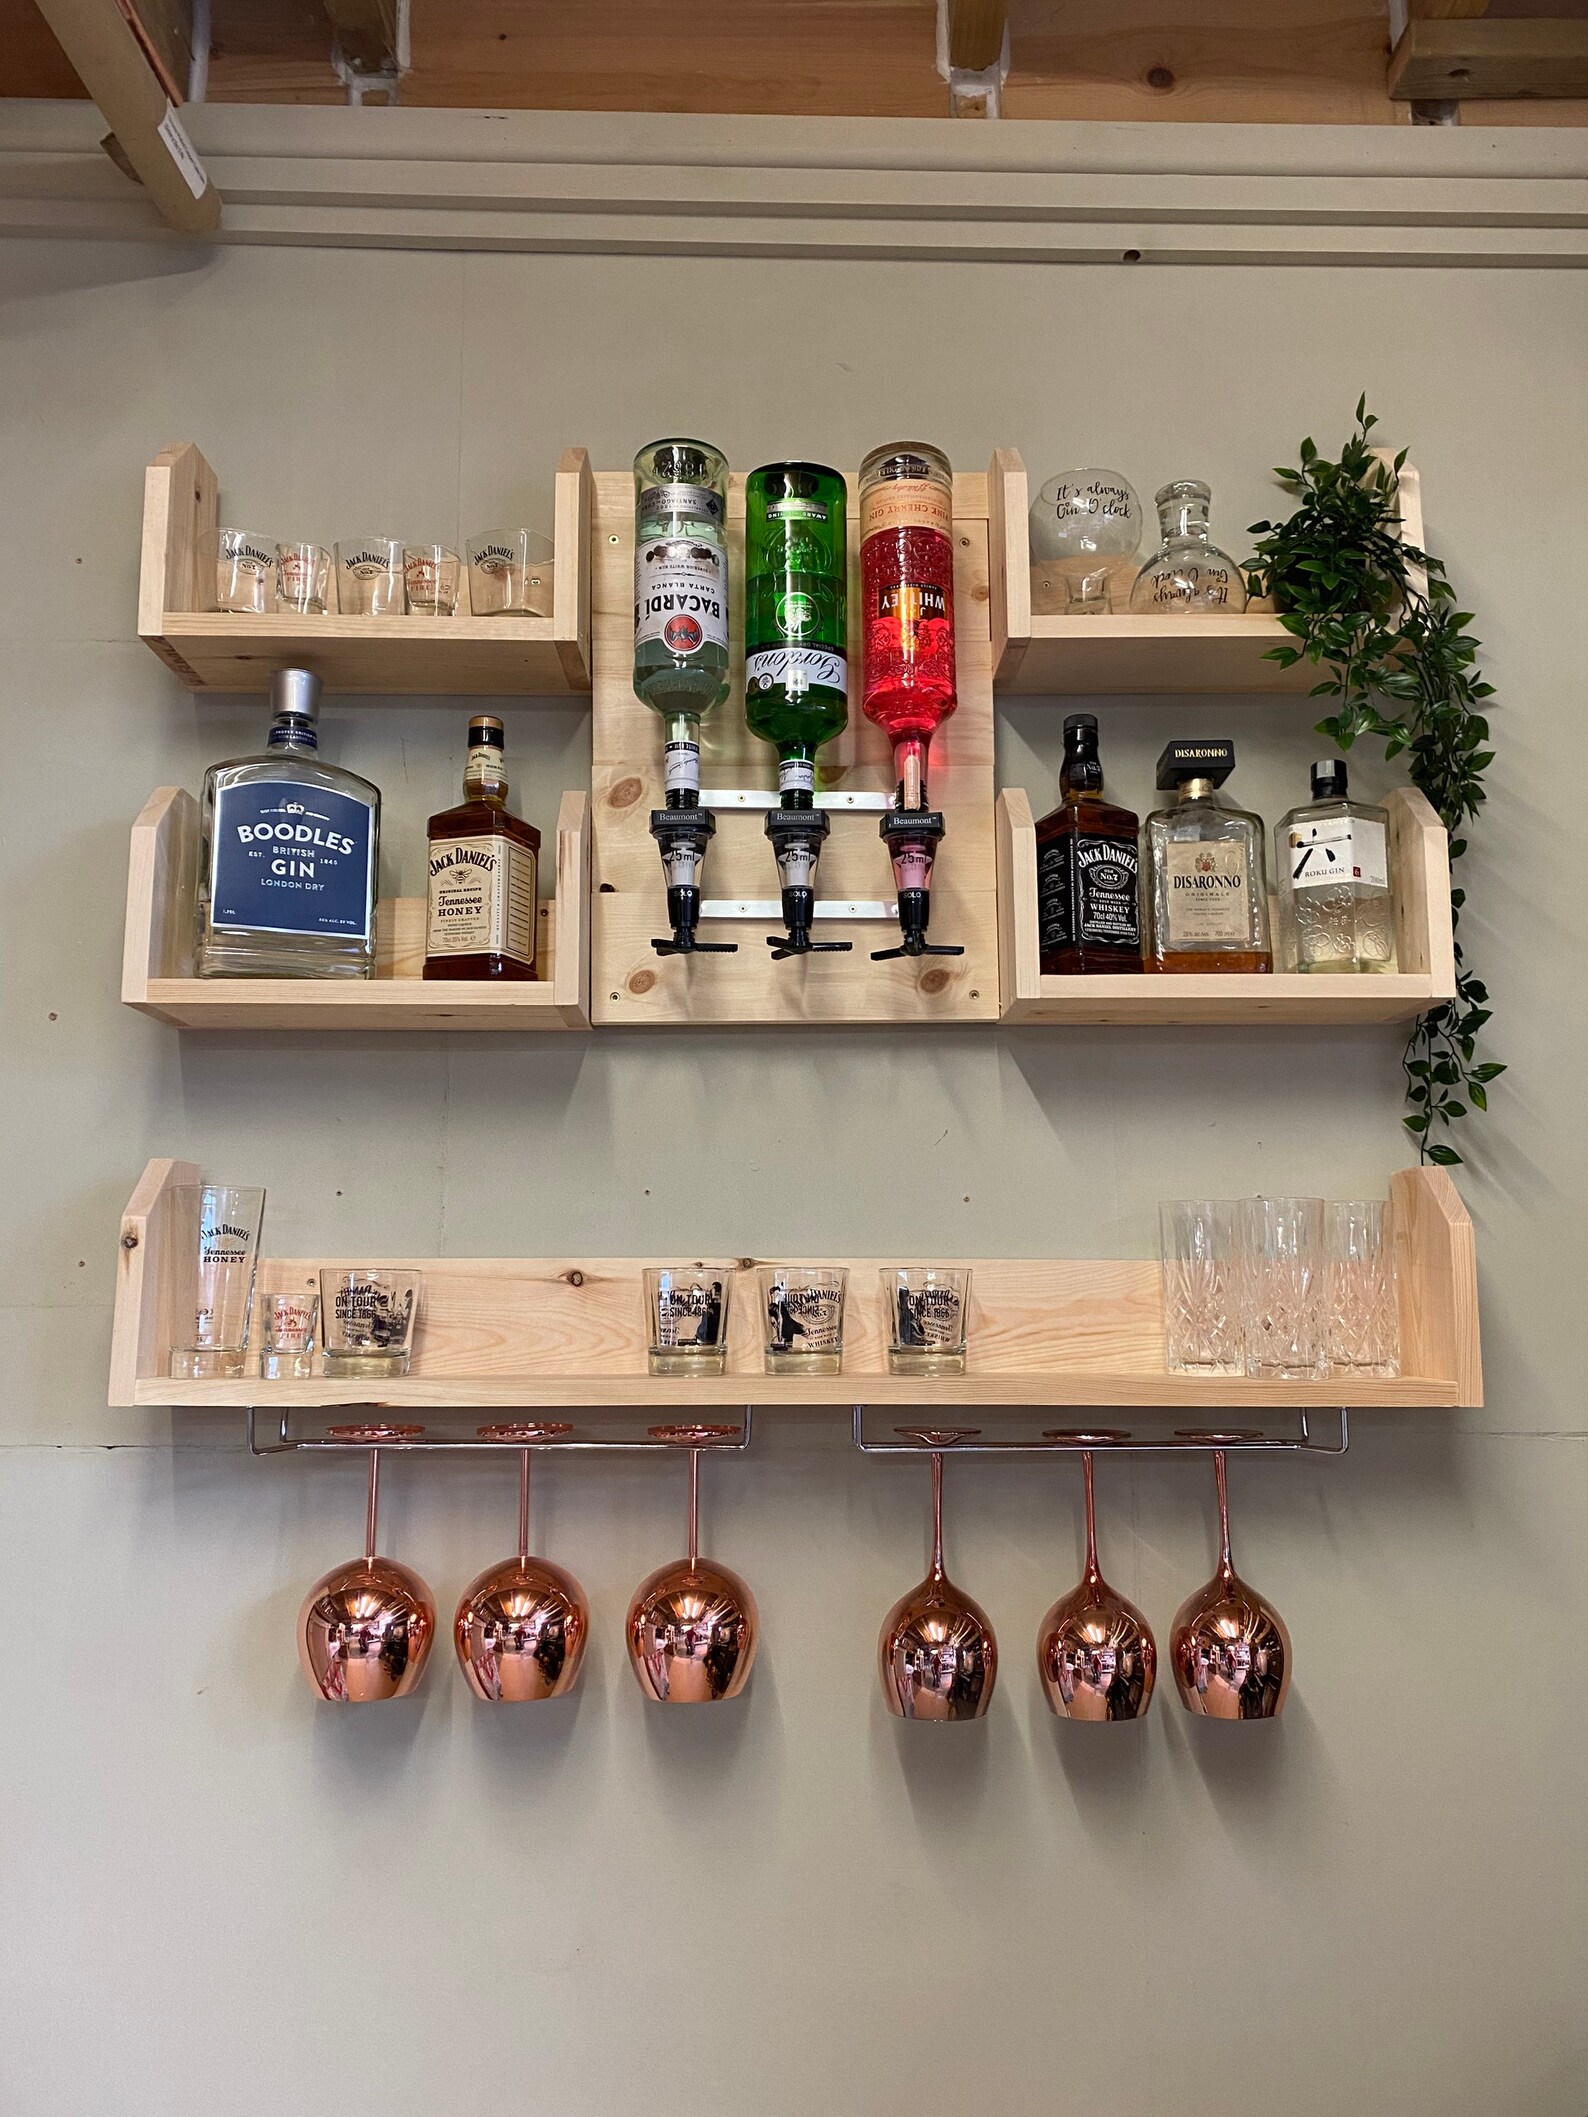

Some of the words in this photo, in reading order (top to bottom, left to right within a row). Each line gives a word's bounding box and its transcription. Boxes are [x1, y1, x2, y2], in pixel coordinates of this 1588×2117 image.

[1056, 483, 1082, 501] It's
[1087, 481, 1130, 502] always
[888, 504, 928, 513] CHERRY
[1057, 502, 1079, 519] Gin
[869, 509, 883, 521] GIN
[246, 545, 274, 568] DANIEL'S
[346, 555, 361, 569] JACK
[362, 552, 390, 569] DANIEL'S
[474, 549, 487, 566] JACK
[488, 545, 515, 560] DANIEL'S
[652, 582, 684, 590] BLANCA
[689, 583, 714, 594] CARTA
[645, 594, 720, 620] BACARDÍ
[882, 592, 945, 611] WHITEY
[1175, 748, 1228, 758] DISARONNO
[237, 823, 355, 855] BOODLES
[272, 846, 315, 858] BRITISH
[1077, 848, 1102, 867] JACK
[430, 852, 454, 876] JACK
[456, 847, 497, 871] DANIEL'S
[271, 858, 315, 878] GIN
[1100, 873, 1118, 881] No.7
[1174, 875, 1241, 890] DISARONNO
[261, 878, 302, 888] LONDON
[305, 882, 324, 891] DRY
[1089, 887, 1130, 901] Tennessee
[438, 896, 482, 906] Tennessee
[438, 906, 482, 916] HONEY
[1090, 903, 1130, 913] WHISKEY
[1093, 912, 1105, 920] 70cl
[201, 1227, 221, 1240] JACK
[222, 1224, 250, 1241] DANIEL'S
[204, 1246, 246, 1255] Tennessee
[335, 1296, 347, 1307] ON
[351, 1296, 376, 1307] TOUR
[686, 1294, 712, 1305] TOUR
[274, 1309, 289, 1320] JACK
[289, 1306, 311, 1320] DANIEL'S
[335, 1309, 357, 1319] SINCE
[670, 1307, 691, 1317] SINCE
[807, 1337, 839, 1348] WHISKEY
